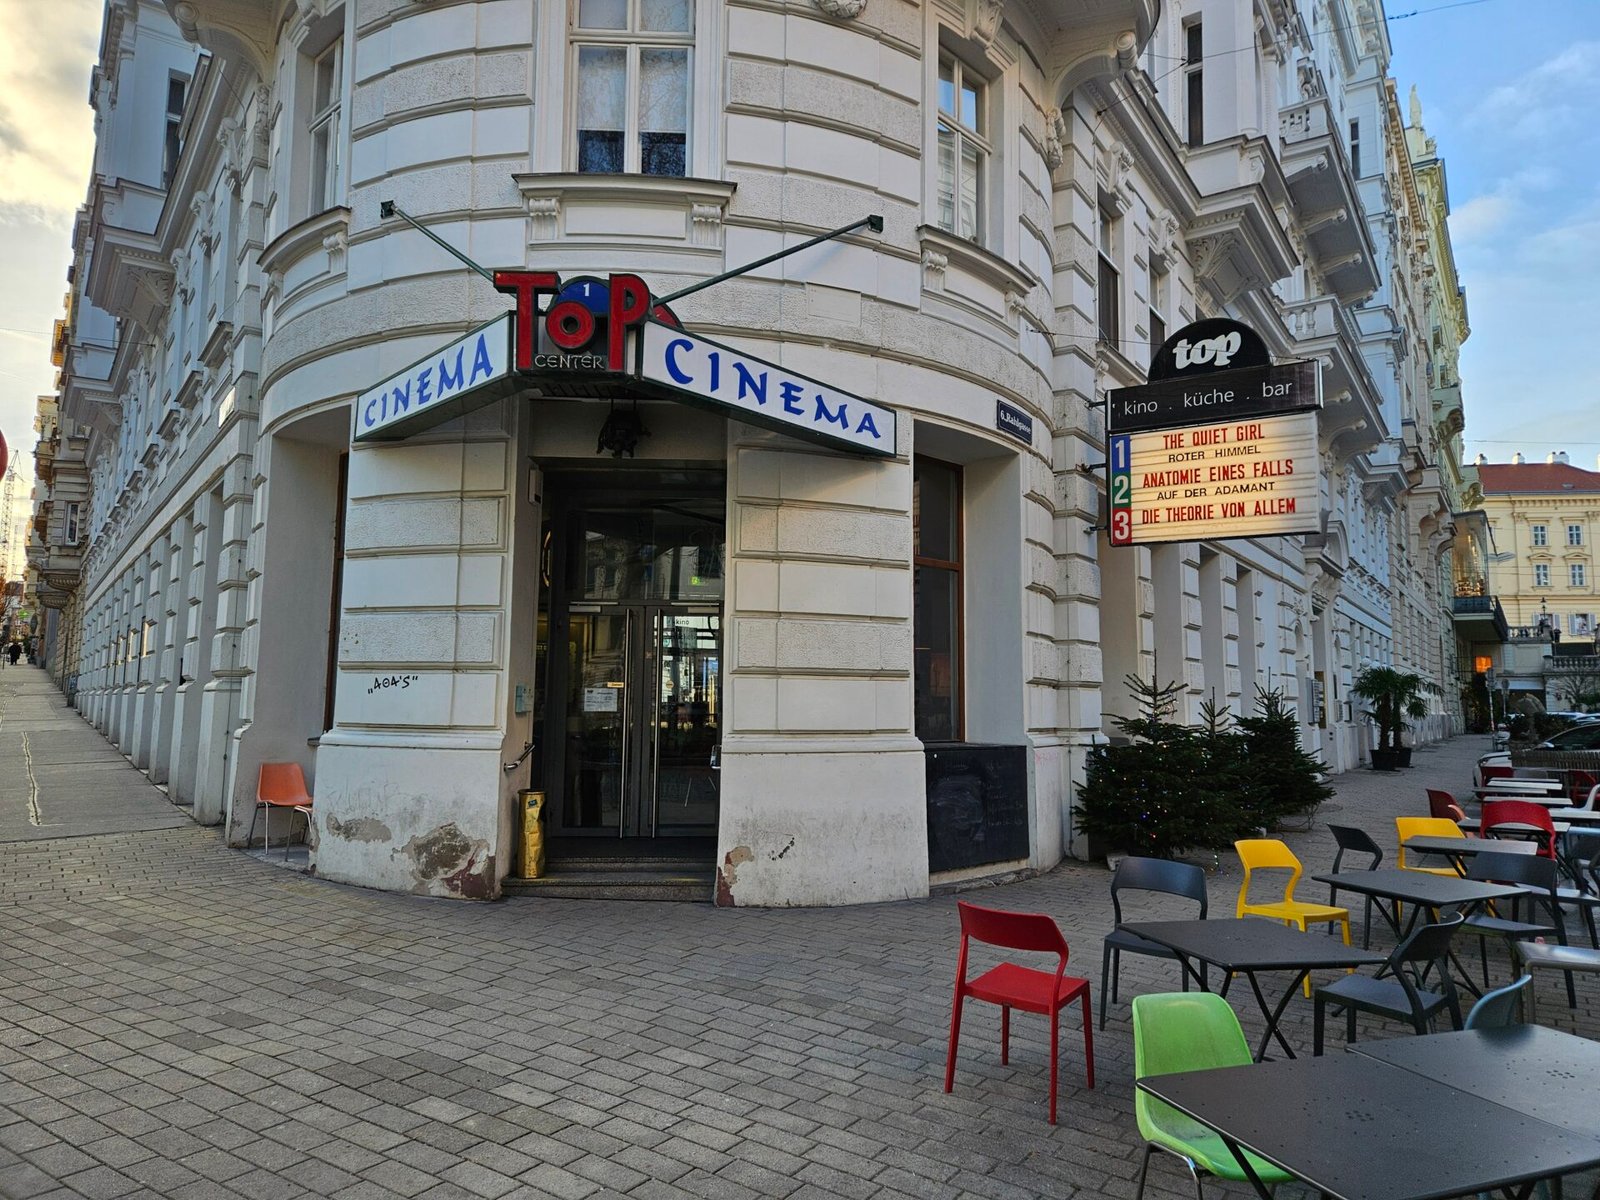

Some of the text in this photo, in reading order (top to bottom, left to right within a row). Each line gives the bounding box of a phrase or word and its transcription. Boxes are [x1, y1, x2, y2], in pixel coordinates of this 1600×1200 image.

[583, 282, 590, 297] 1
[534, 354, 605, 369] CENTER
[1172, 331, 1242, 370] top
[364, 333, 494, 428] CINEMA
[664, 338, 881, 439] CINEMA
[1124, 382, 1293, 415] kino küche bar
[1163, 423, 1265, 450] THE QUIET GIRL
[1115, 439, 1126, 469] 1
[1168, 445, 1261, 463] ROTER HIMMEL
[1142, 458, 1294, 488] ANATOMIE EINES FALLS
[1114, 475, 1129, 504] 2
[1157, 481, 1275, 501] AUF DER ADAMANT
[1114, 511, 1130, 540] 3
[1142, 497, 1296, 525] DIE THEORIE VON ALLEM
